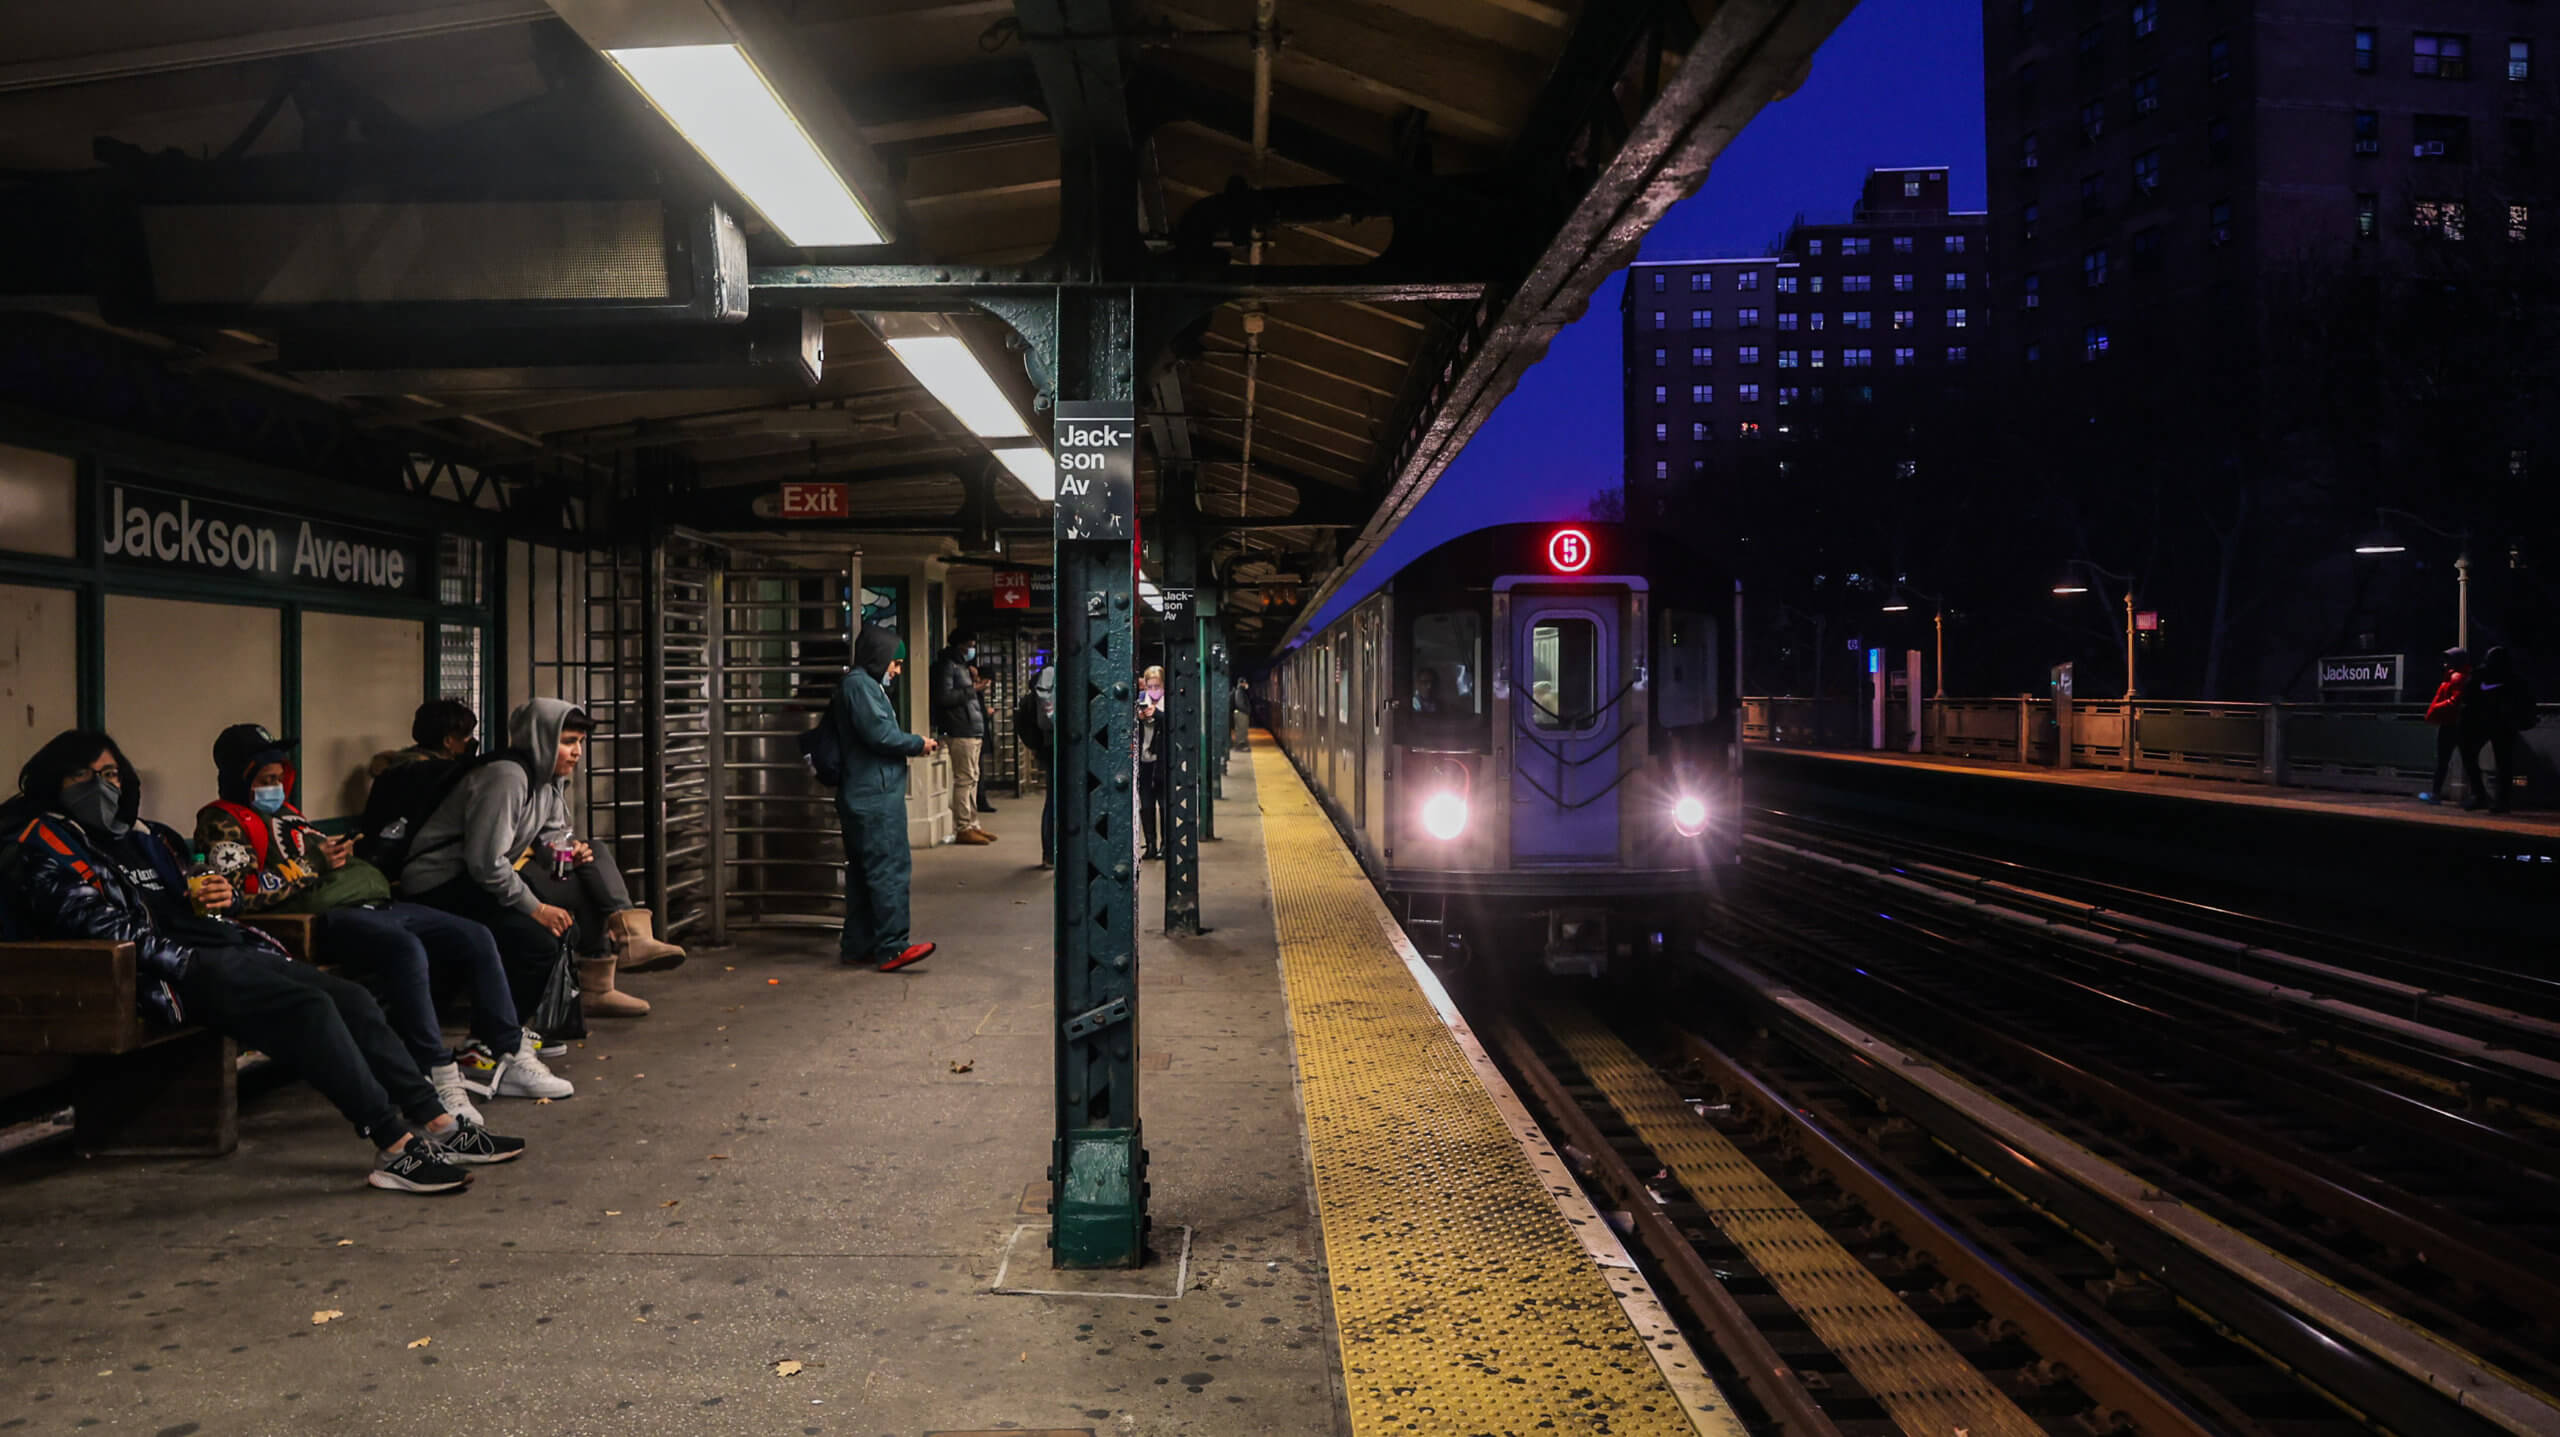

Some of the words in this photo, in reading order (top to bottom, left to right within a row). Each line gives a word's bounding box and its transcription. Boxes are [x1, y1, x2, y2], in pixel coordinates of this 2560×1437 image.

[1060, 424, 1132, 446] Jack-
[1060, 452, 1105, 469] son
[1060, 474, 1090, 496] Av
[783, 486, 839, 512] Exit
[103, 487, 277, 573] Jackson
[293, 521, 404, 589] Avenue
[1563, 537, 1578, 564] 5
[994, 572, 1025, 588] Exit
[1163, 591, 1194, 601] Jack-
[1163, 602, 1183, 610] son
[1163, 611, 1177, 621] Av
[2322, 664, 2370, 681] Jackson
[2374, 663, 2389, 680] Av
